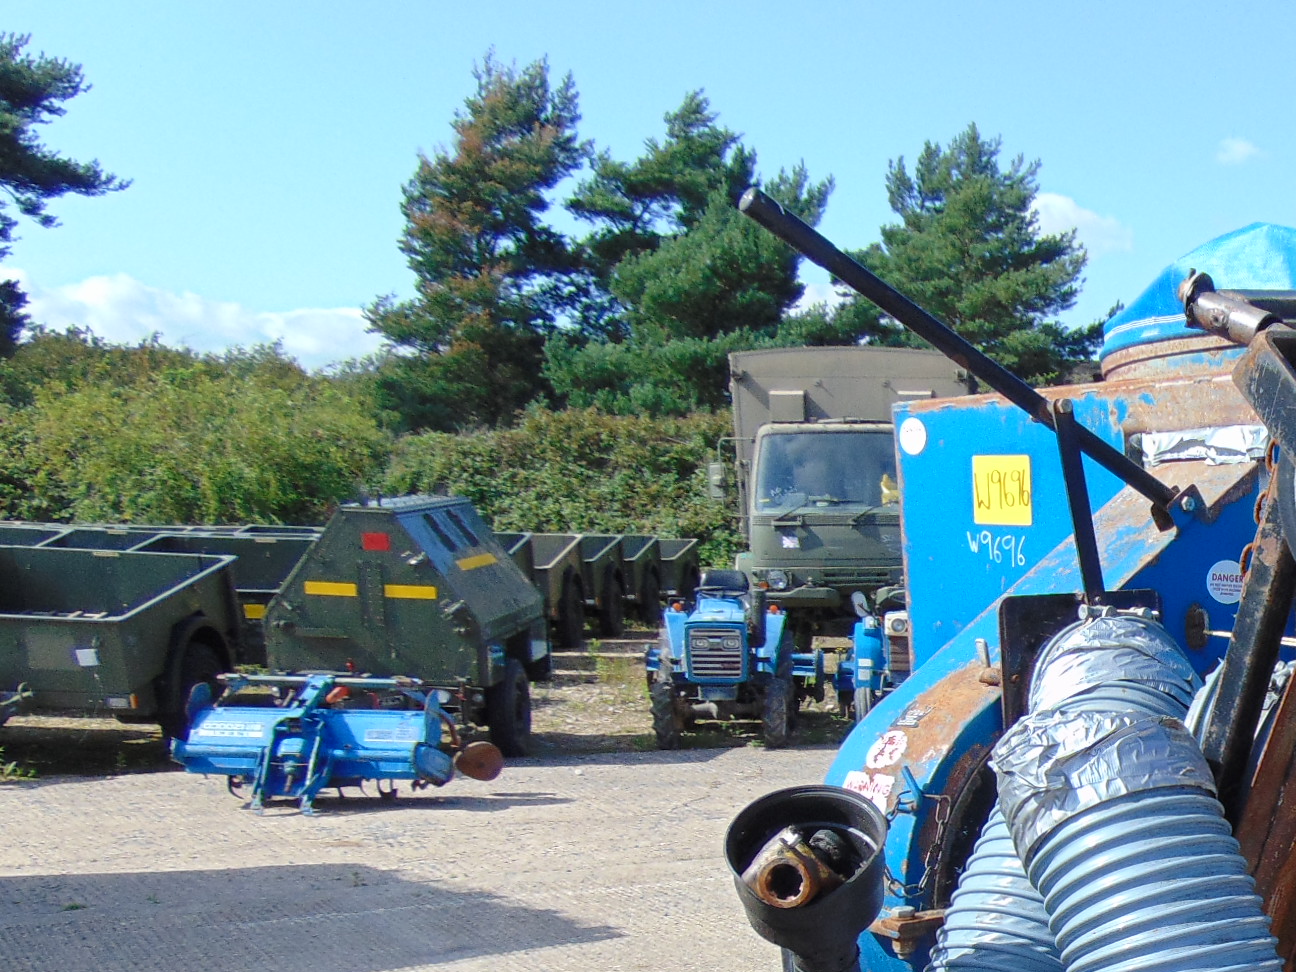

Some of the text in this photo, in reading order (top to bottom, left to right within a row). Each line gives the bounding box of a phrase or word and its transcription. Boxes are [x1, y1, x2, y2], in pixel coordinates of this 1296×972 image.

[973, 469, 1030, 510] W9696
[966, 530, 1026, 568] W9696
[1212, 572, 1244, 583] DANGER
